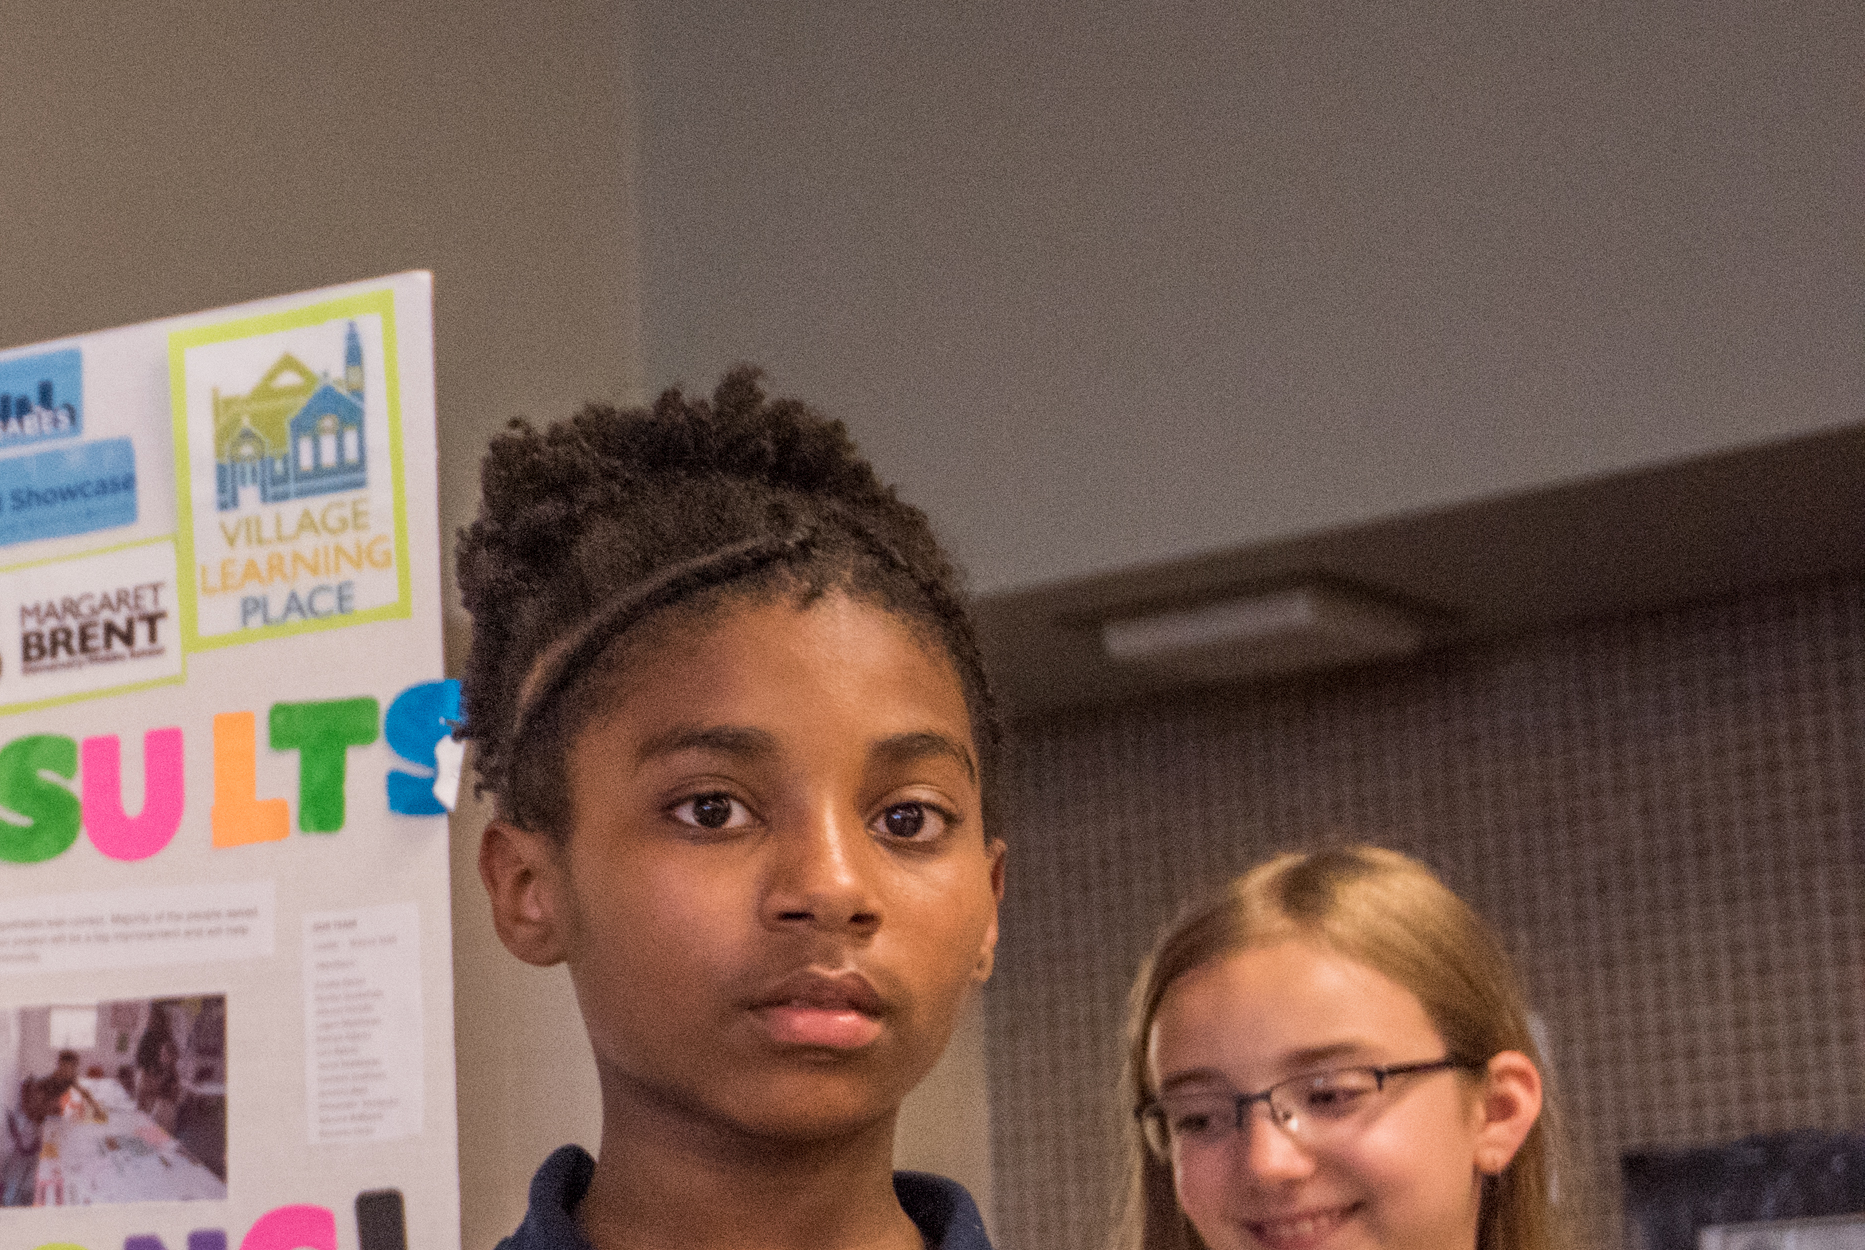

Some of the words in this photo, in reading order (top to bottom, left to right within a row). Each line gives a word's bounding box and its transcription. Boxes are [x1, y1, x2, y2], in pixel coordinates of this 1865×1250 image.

[10, 472, 134, 515] Showcase
[219, 498, 371, 548] VILLAGE
[200, 535, 393, 596] LEARNING
[20, 580, 167, 627] MARGARET
[240, 580, 356, 629] PLACE
[20, 612, 168, 665] BRENT
